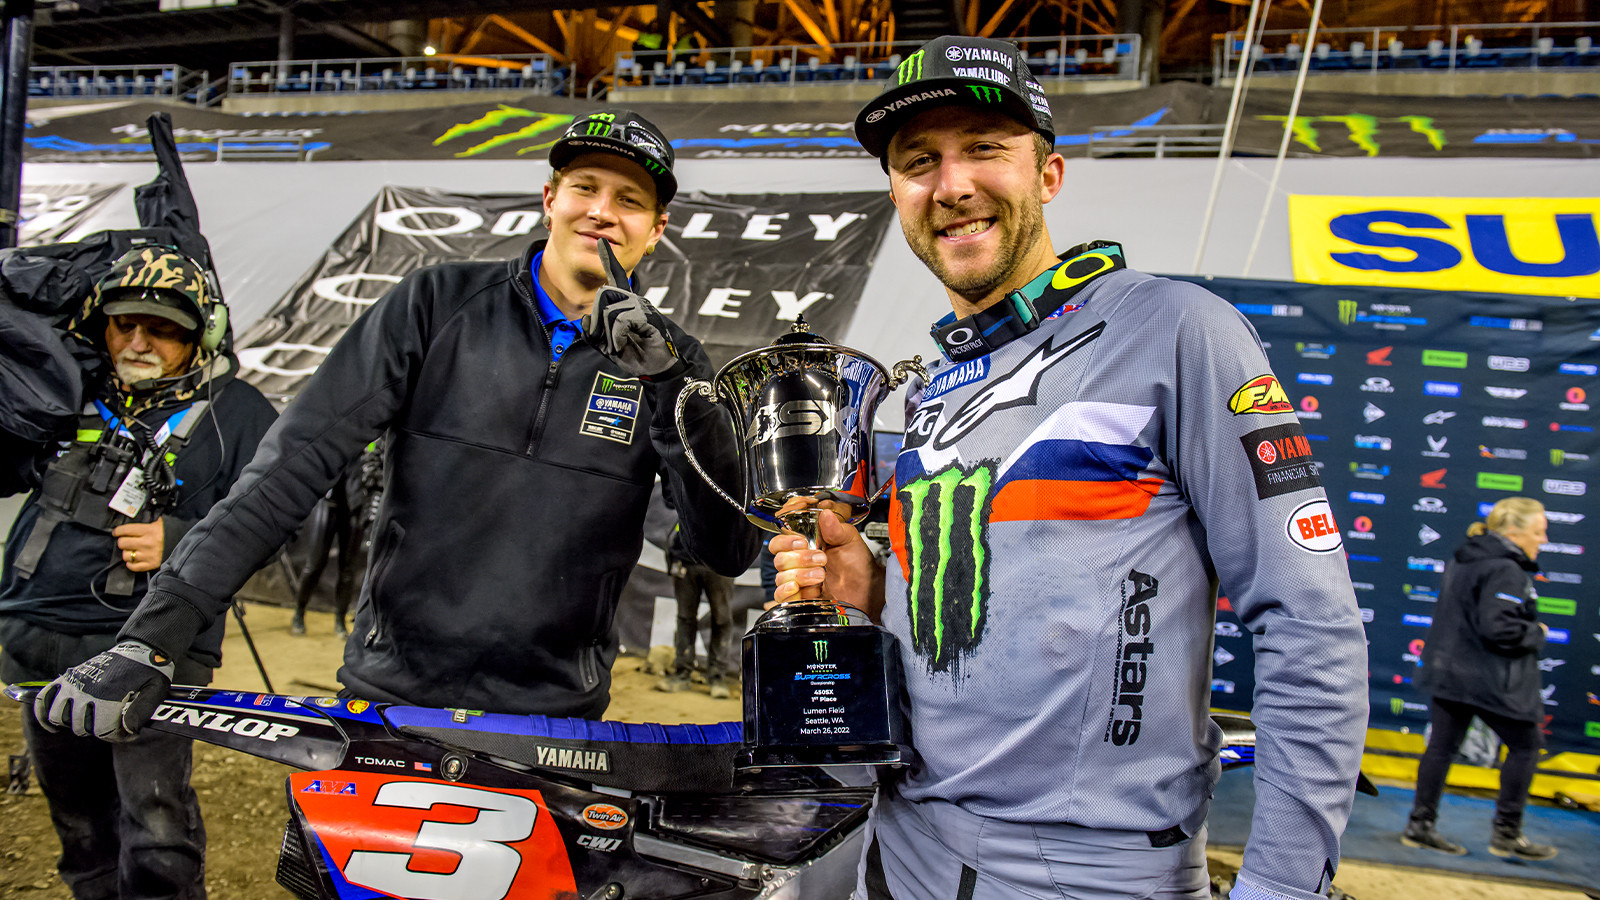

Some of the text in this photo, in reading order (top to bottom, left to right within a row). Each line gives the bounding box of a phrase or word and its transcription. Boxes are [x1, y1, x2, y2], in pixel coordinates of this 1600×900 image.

[962, 47, 1013, 72] YAMAHA
[952, 66, 1011, 88] YAMALUBE
[884, 88, 957, 112] YAMAHA
[585, 140, 635, 158] YAMAHA
[969, 338, 984, 351] PILOT
[935, 358, 984, 396] YAMAHA
[604, 399, 632, 412] YAMAHA
[1267, 467, 1309, 485] FINANCIAL
[1111, 568, 1158, 747] Astars
[794, 673, 851, 681] SUPERCROSS
[829, 706, 845, 714] Field
[150, 704, 300, 742] UNLOP
[805, 717, 831, 725] Seattle,
[800, 727, 821, 735] March
[822, 727, 833, 735] 26,
[355, 756, 405, 768] TOMAC
[536, 745, 608, 771] YAMAHA
[301, 779, 358, 795] AMA
[588, 810, 626, 824] Twin Air
[343, 781, 538, 900] 3
